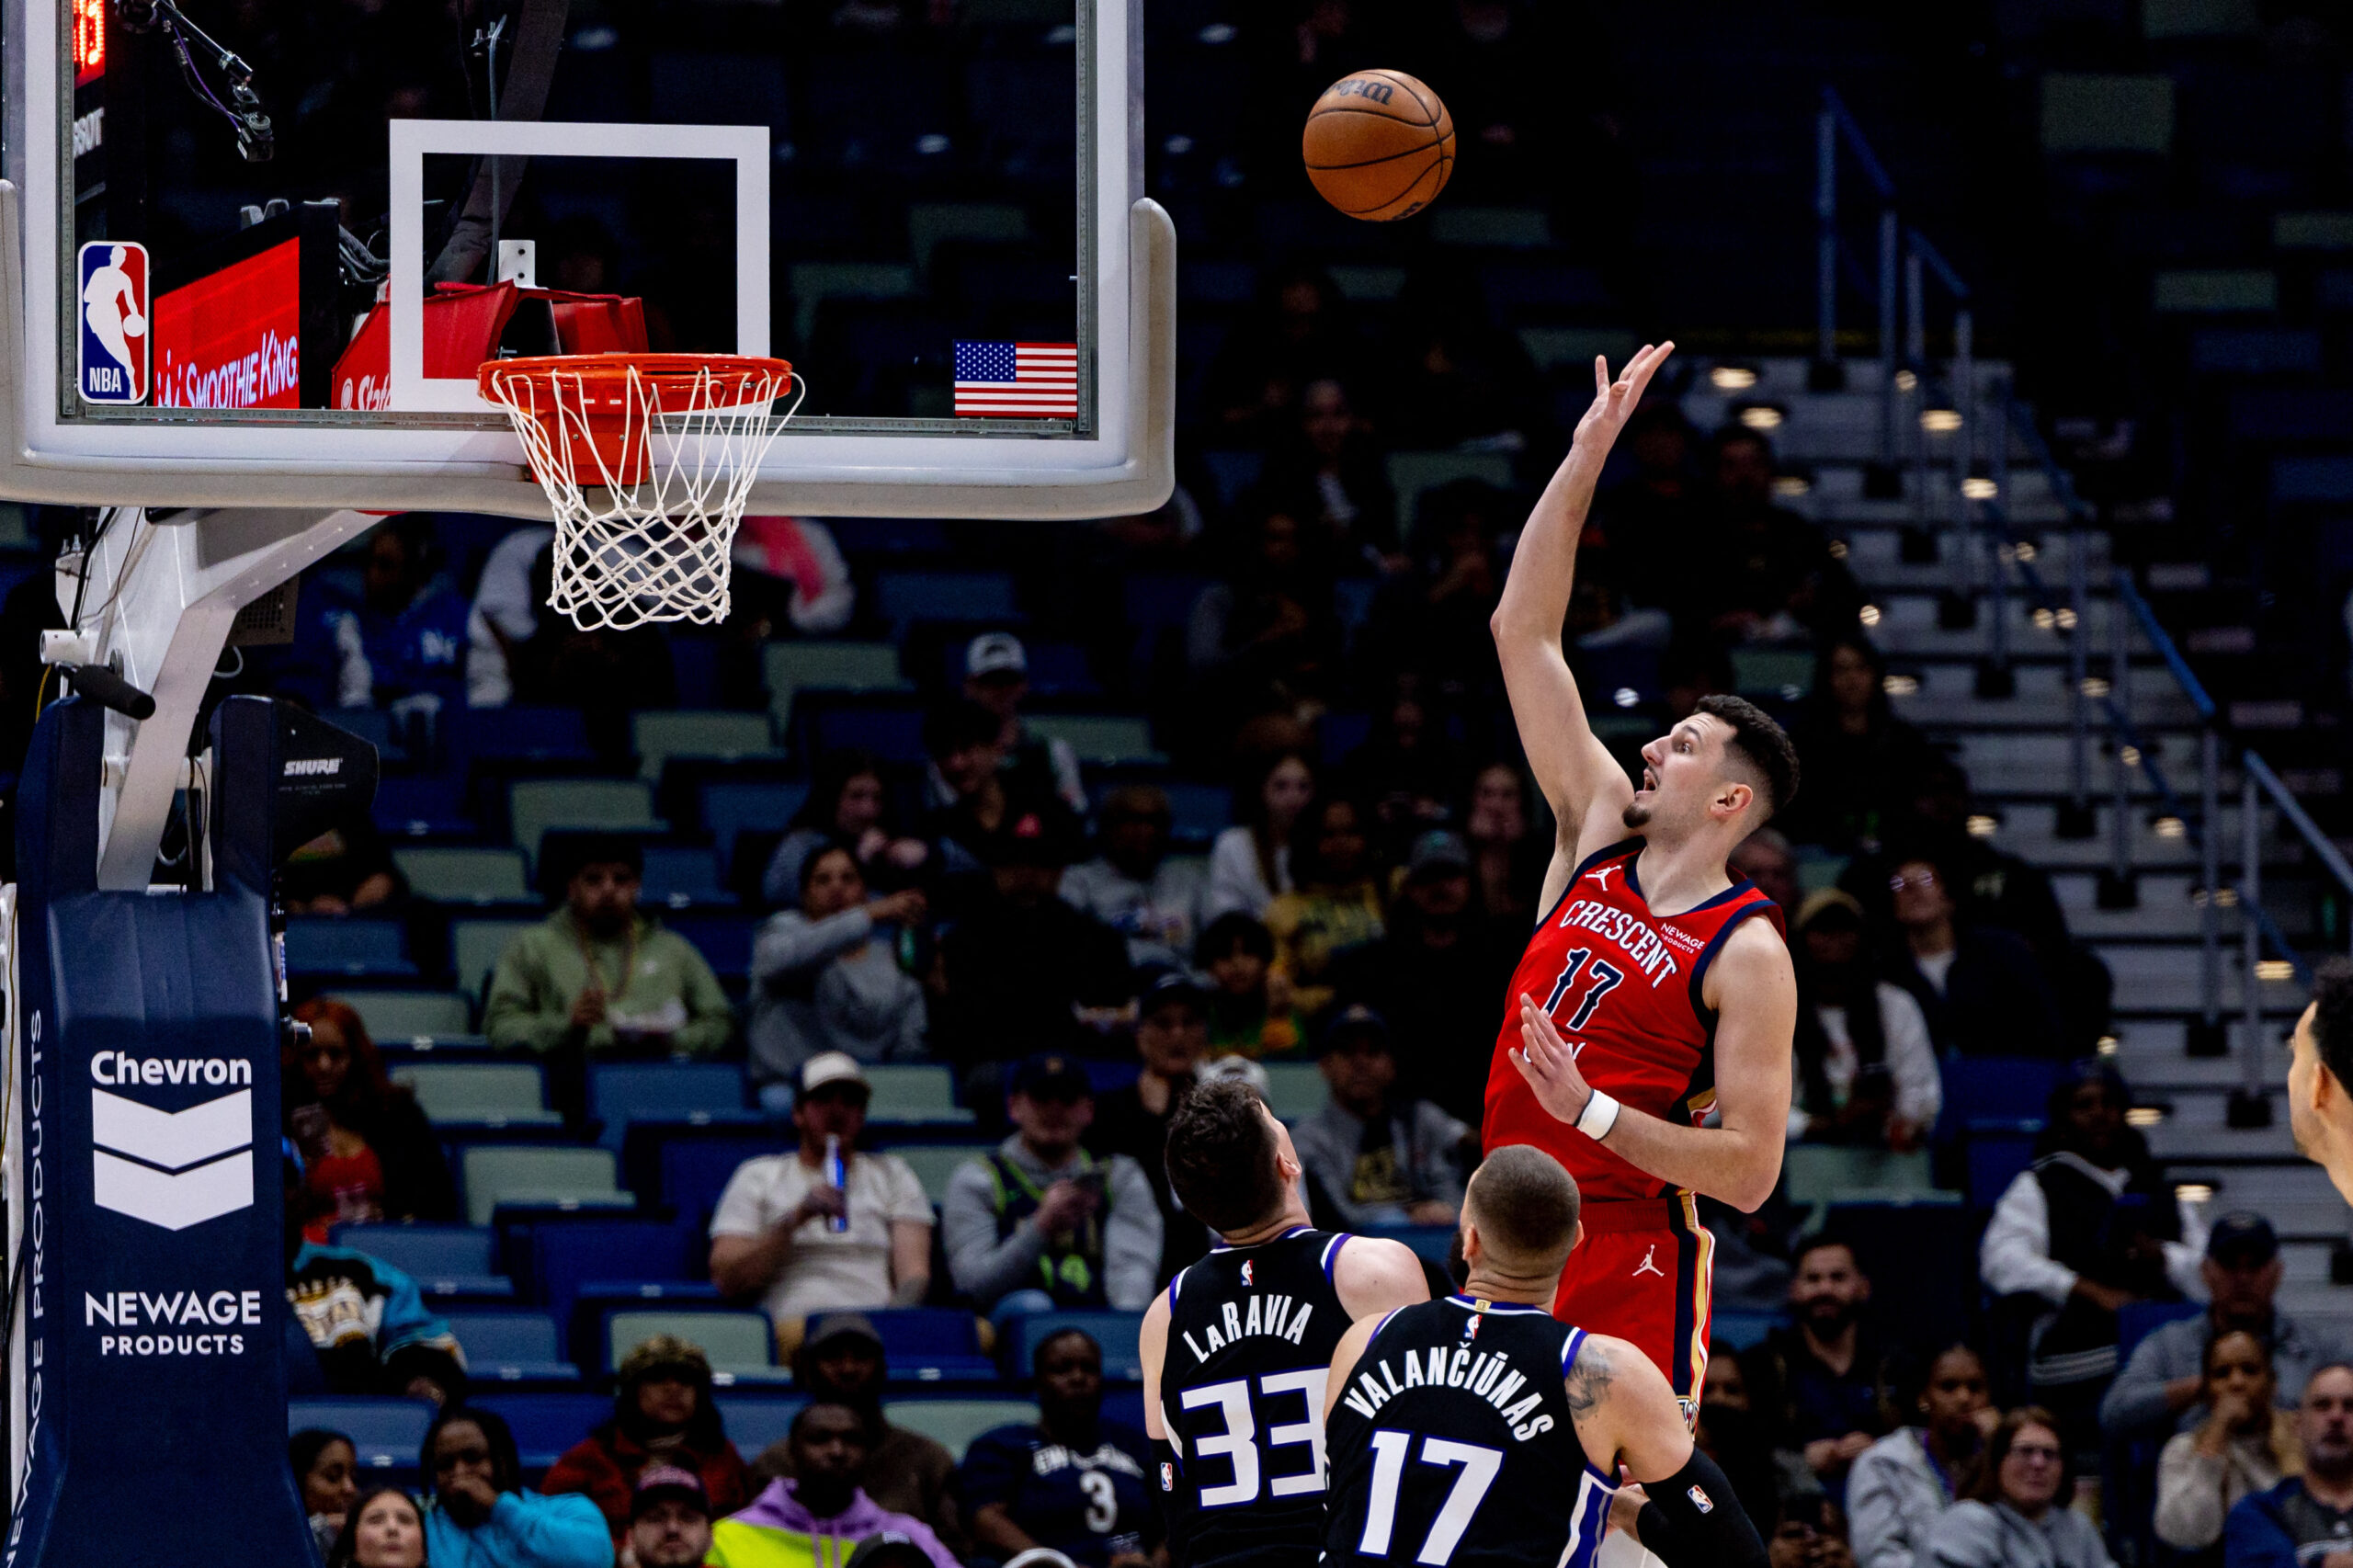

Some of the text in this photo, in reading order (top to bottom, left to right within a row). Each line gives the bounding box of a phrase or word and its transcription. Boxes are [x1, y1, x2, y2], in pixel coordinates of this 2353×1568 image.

[89, 368, 122, 392] NBA
[186, 351, 259, 408] SMOOTHIE
[283, 757, 341, 777] SHURE
[1559, 900, 1677, 989] CRESCENT
[1660, 922, 1706, 949] NEWAGE
[1542, 947, 1624, 1031] 17
[90, 1051, 252, 1085] Chevron
[30, 1010, 44, 1319] PRODUCTS
[85, 1290, 261, 1327] NEWAGE
[101, 1335, 244, 1356] PRODUCTS
[1344, 1341, 1554, 1442] VALANČIŪNAS
[1180, 1367, 1330, 1508] 33
[1079, 1471, 1118, 1533] 3
[1358, 1429, 1504, 1567] 17
